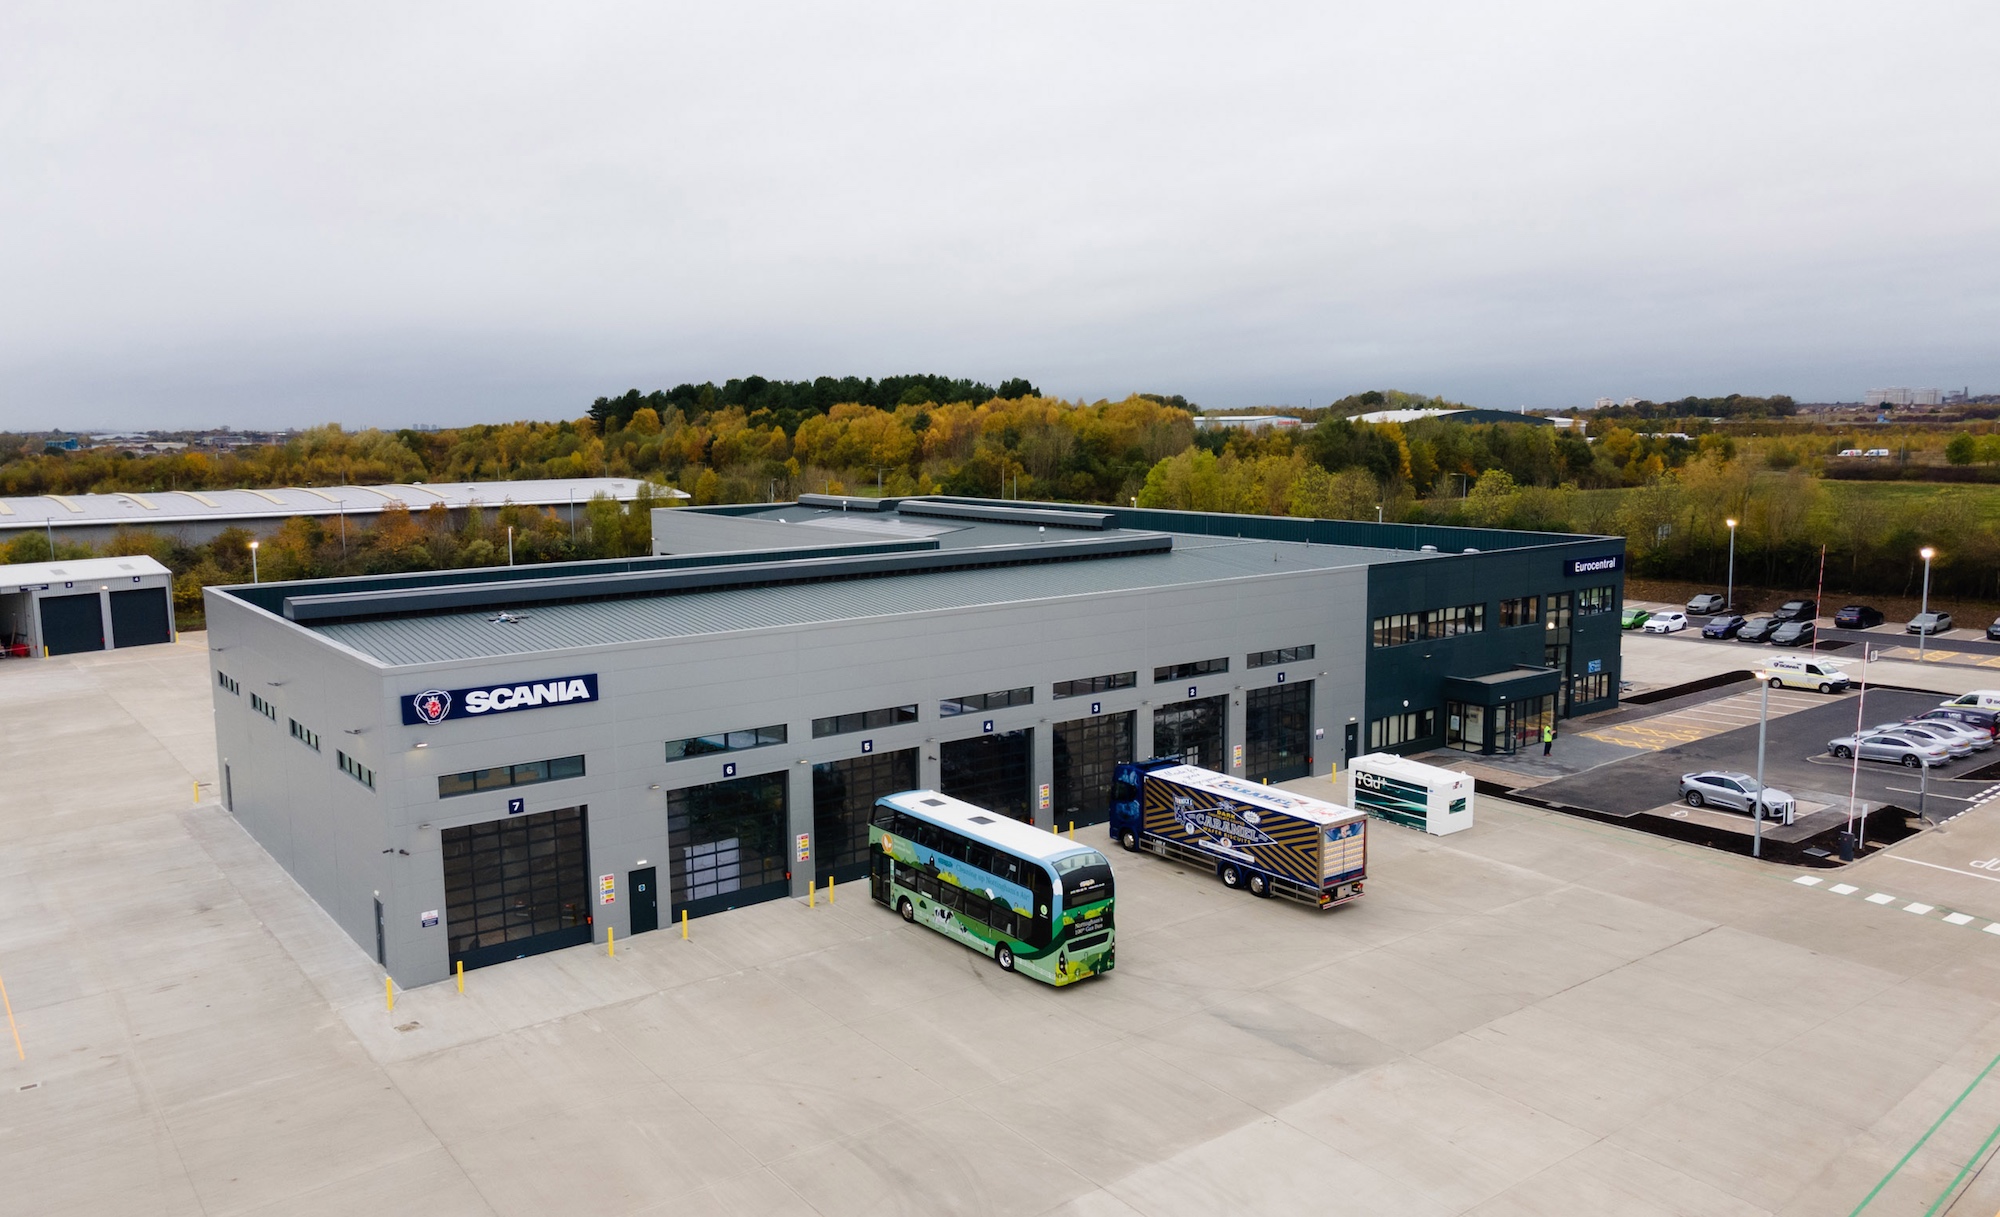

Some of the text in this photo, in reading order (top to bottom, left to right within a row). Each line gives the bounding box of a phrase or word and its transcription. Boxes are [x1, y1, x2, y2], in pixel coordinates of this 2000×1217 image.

[1574, 557, 1616, 573] Eurocentral
[465, 679, 590, 713] SCANIA
[1190, 688, 1196, 696] 2
[1093, 704, 1099, 712] 3
[985, 722, 992, 730] 4
[864, 742, 871, 751] 5
[726, 765, 733, 775] 6
[1218, 783, 1292, 805] CARAMEL
[512, 801, 520, 811] 7
[1216, 809, 1236, 820] DARK
[1195, 812, 1259, 843] CARAMEL
[1203, 826, 1222, 836] WAFER
[1223, 832, 1251, 845] BISCUITS
